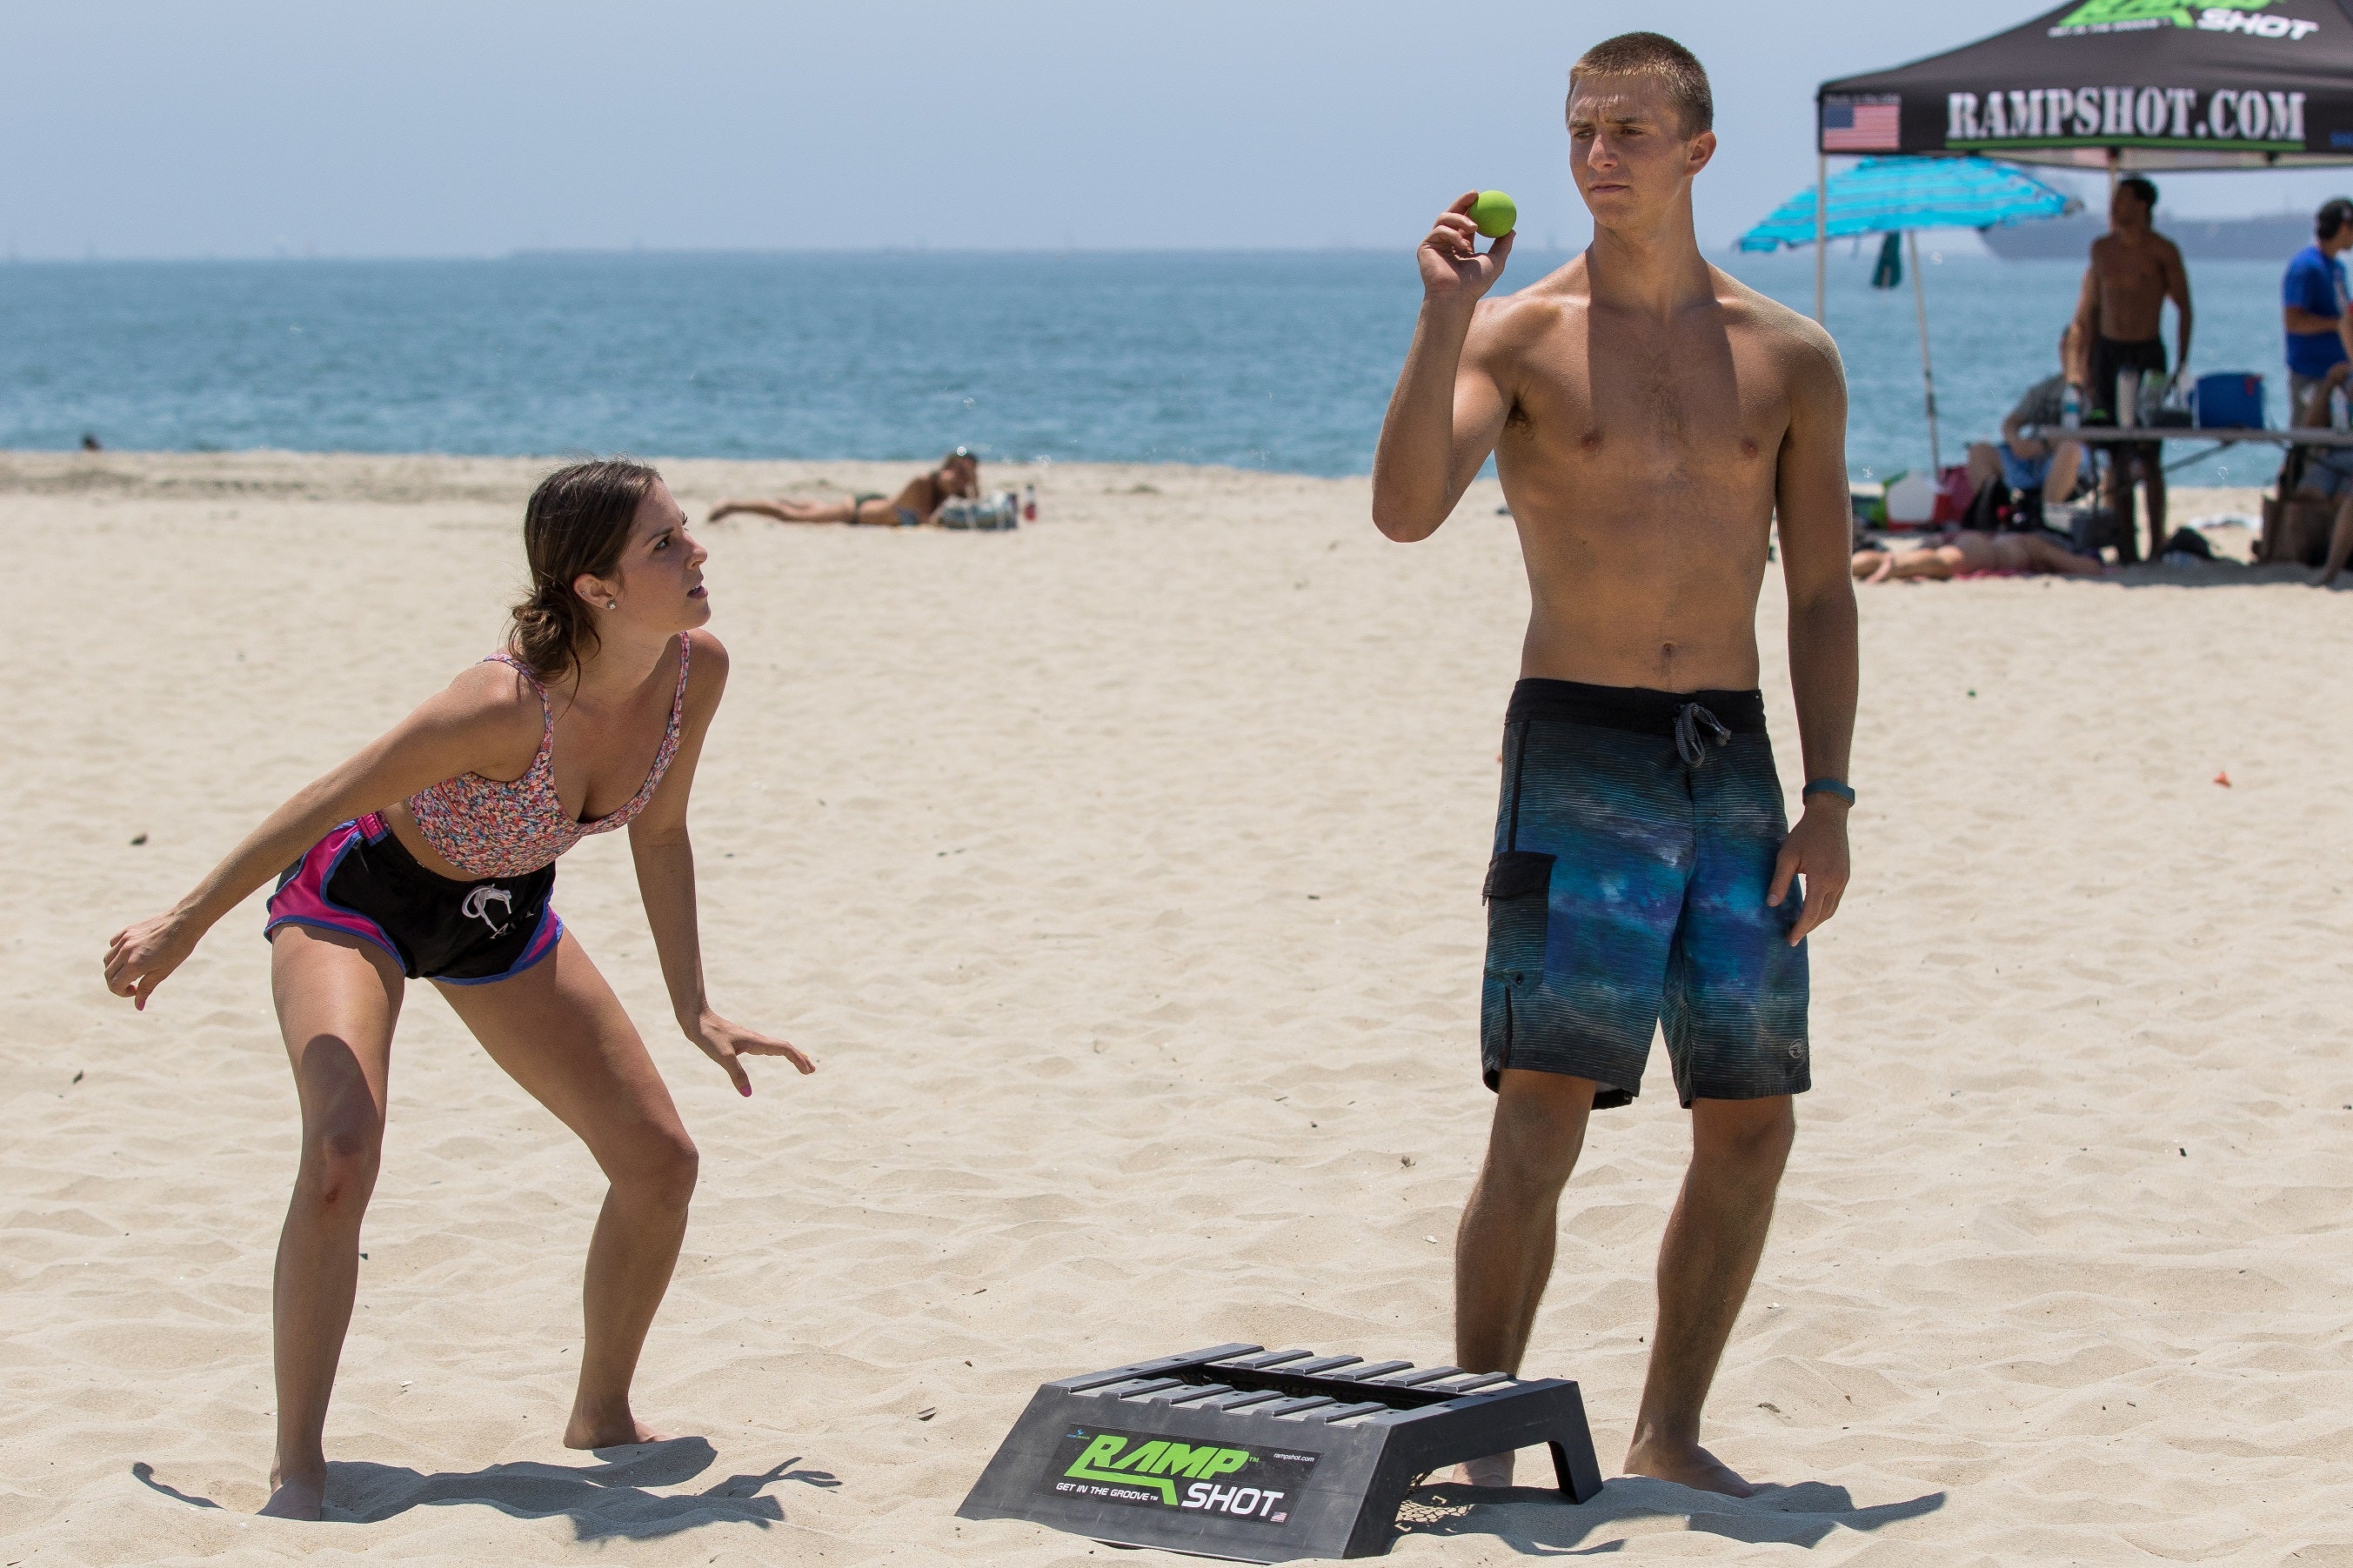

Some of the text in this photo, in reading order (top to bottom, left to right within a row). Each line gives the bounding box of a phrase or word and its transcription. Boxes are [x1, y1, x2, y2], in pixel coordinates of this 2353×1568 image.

[2196, 7, 2320, 40] SHOT
[1946, 87, 2306, 140] RAMPSHOT.COM
[1064, 1434, 1250, 1480] RAMP
[1273, 1452, 1315, 1462] rampshot.com
[1056, 1482, 1076, 1491] GET
[1076, 1485, 1089, 1493] IN
[1090, 1485, 1109, 1496] THE
[1110, 1489, 1151, 1501] GROOVE
[1181, 1483, 1285, 1517] SHOT
